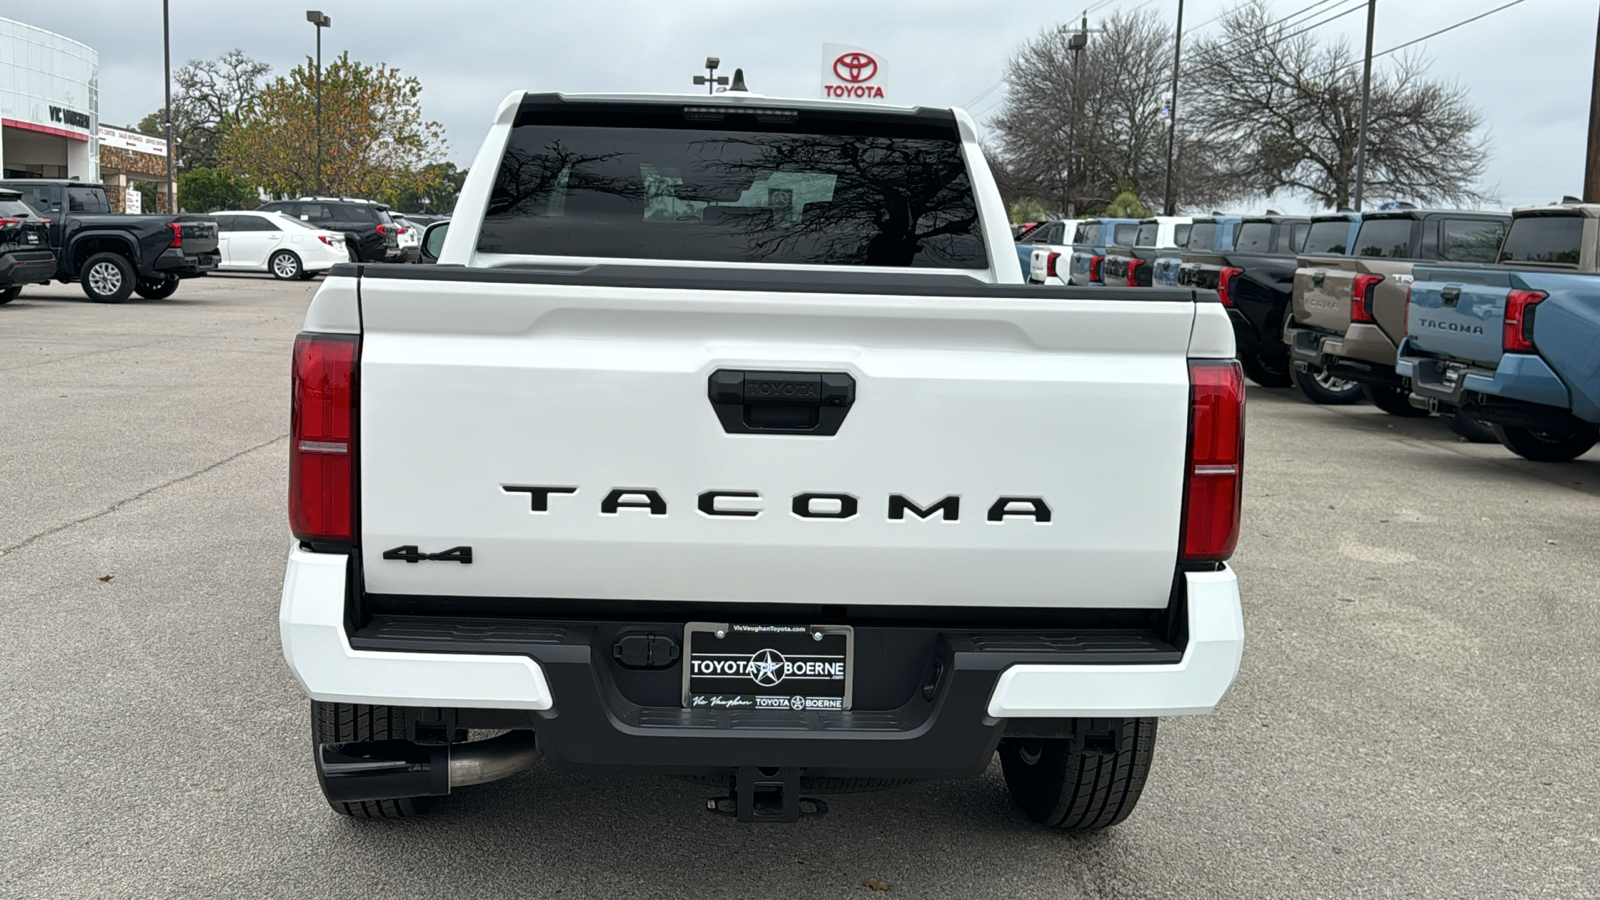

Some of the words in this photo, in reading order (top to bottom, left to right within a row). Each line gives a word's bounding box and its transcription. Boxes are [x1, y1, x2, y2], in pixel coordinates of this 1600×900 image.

[824, 85, 884, 98] TOYOTA
[49, 105, 62, 123] VIC
[1419, 318, 1484, 335] TACOMA
[747, 382, 818, 397] TOYOTA
[499, 482, 1054, 526] TACOMA
[733, 625, 806, 634] VicVaughanToyota.com
[691, 660, 757, 674] TOYOTA
[760, 662, 777, 672] OF
[784, 662, 844, 675] BOERNE
[692, 696, 708, 707] Vic
[710, 696, 752, 708] Vaughan
[755, 698, 790, 707] TOYOTA
[805, 699, 843, 708] BOERNE
